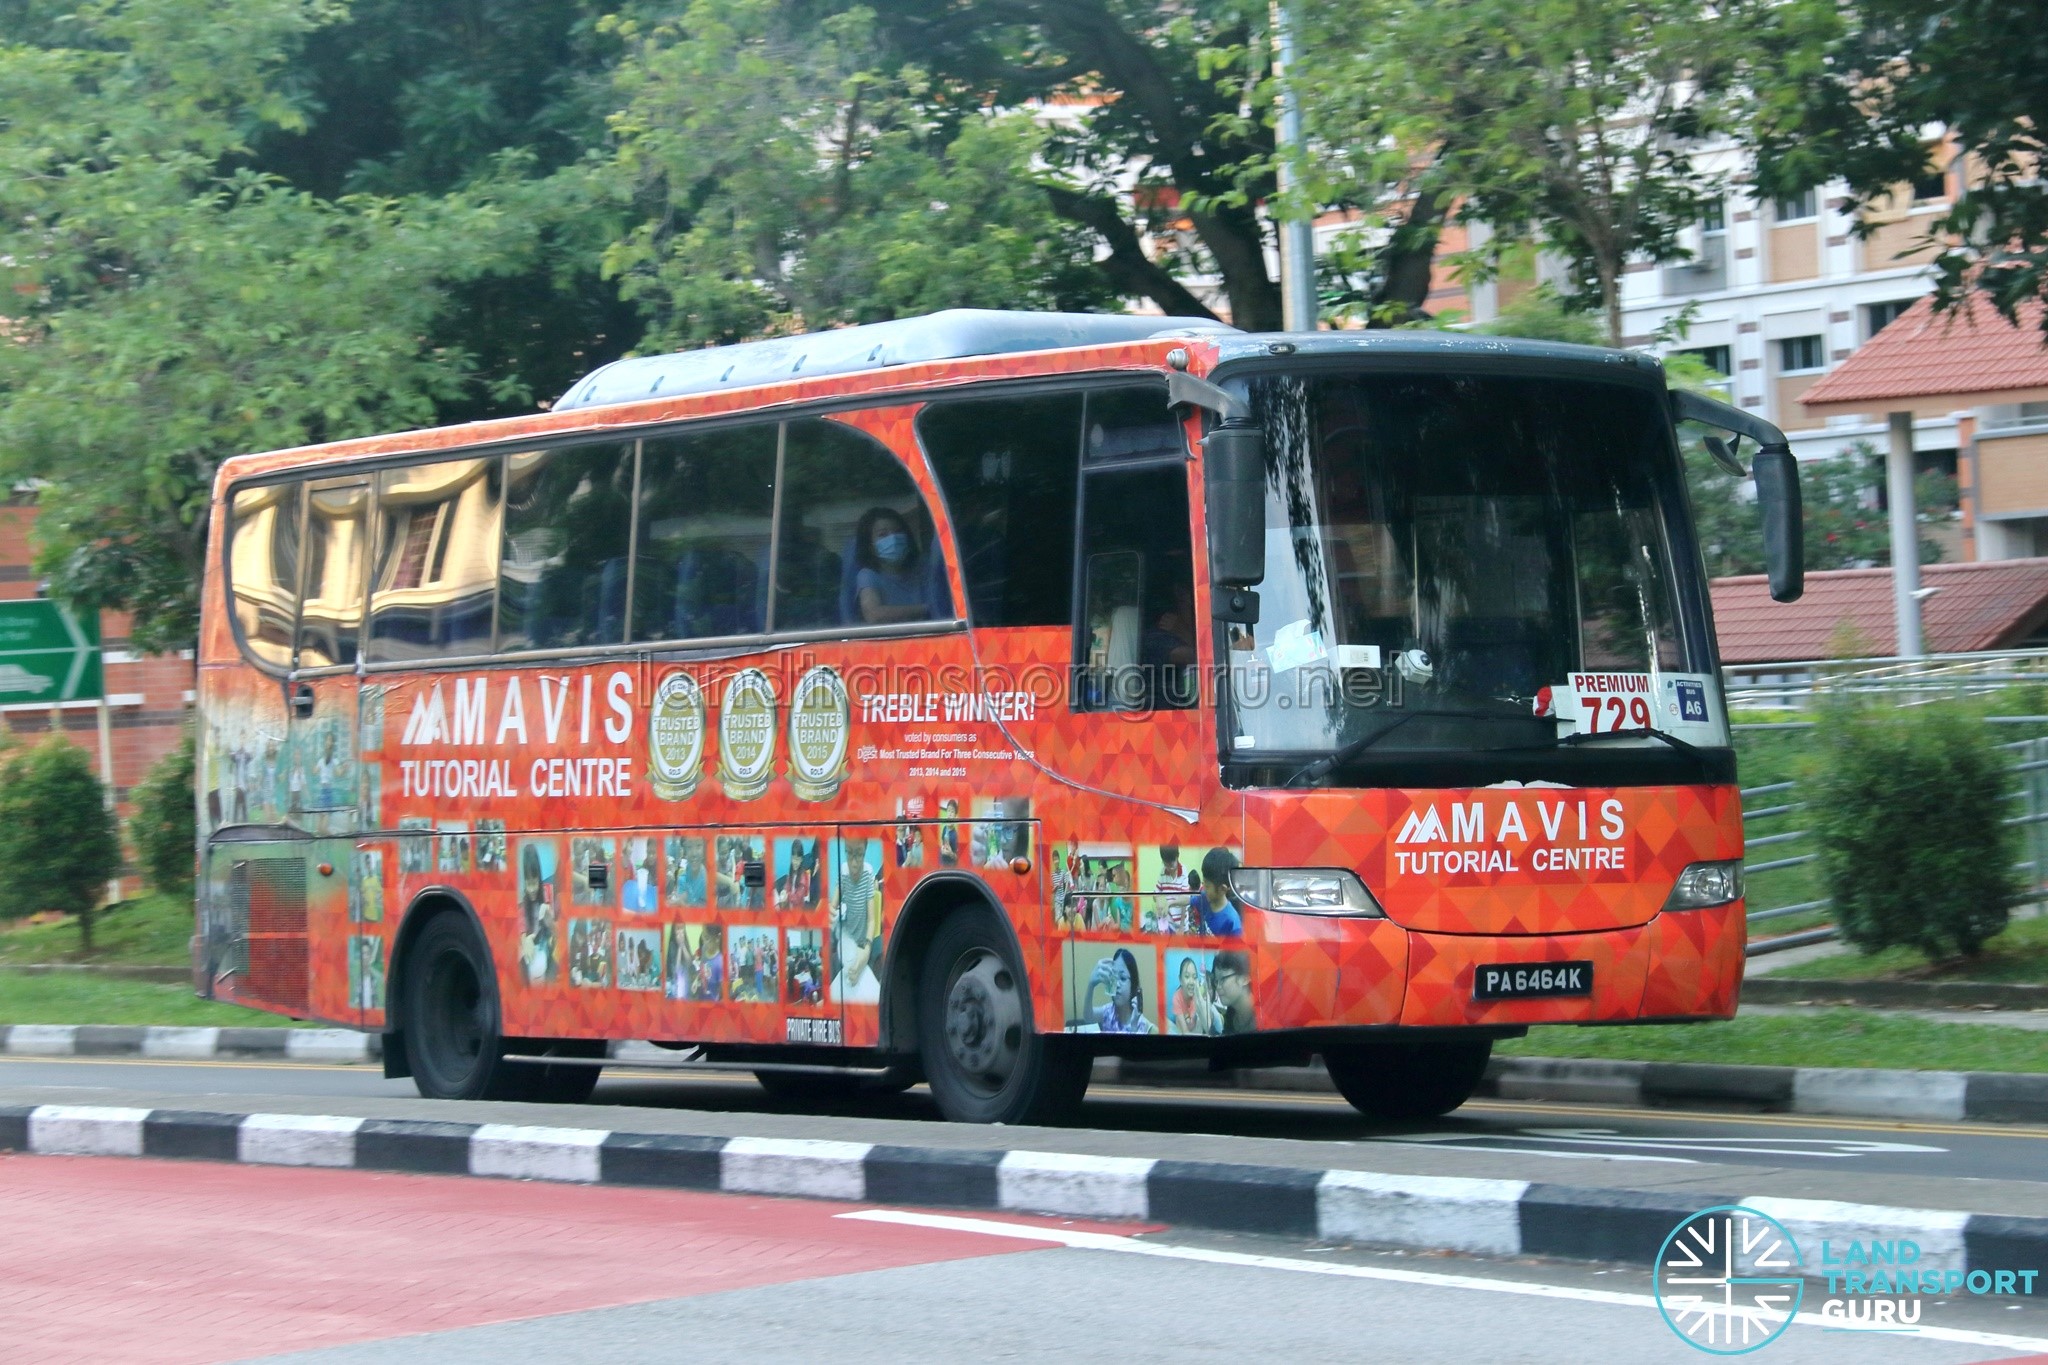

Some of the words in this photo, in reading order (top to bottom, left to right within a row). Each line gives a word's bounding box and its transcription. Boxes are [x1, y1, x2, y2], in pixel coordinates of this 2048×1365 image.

[1574, 674, 1650, 693] PREMIUM
[452, 671, 633, 746] MAVIS
[860, 693, 939, 723] TREBLE
[944, 691, 1036, 723] WINNER!
[1685, 700, 1703, 715] A6
[653, 715, 700, 731] TRUSTED
[724, 713, 772, 730] TRUSTED
[794, 712, 844, 730] TRUSTED
[1581, 696, 1651, 735] 729
[659, 731, 696, 746] BRAND
[729, 730, 767, 745] BRAND
[800, 729, 838, 744] BRAND
[904, 732, 922, 743] voted
[923, 732, 931, 745] by
[932, 733, 967, 743] consumers
[968, 733, 977, 743] as
[665, 747, 686, 761] 2013
[735, 746, 757, 760] 2014
[806, 746, 828, 760] 2015
[879, 749, 895, 759] Most
[896, 748, 920, 759] Trusted
[920, 748, 940, 759] Brand
[941, 749, 952, 759] For
[953, 748, 972, 759] Three
[972, 748, 1013, 760] Consecutive
[399, 758, 518, 798] TUTORIAL
[530, 756, 632, 798] CENTRE
[739, 767, 752, 776] GOLD
[810, 767, 823, 776] GOLD
[925, 767, 939, 777] 2014
[940, 767, 951, 777] and
[952, 767, 966, 777] 2015
[1451, 798, 1625, 843] MAVIS
[1394, 850, 1519, 874] TUTORIAL
[1532, 847, 1625, 871] CENTRE
[1486, 968, 1582, 992] PA6464K
[786, 1017, 812, 1042] PRIVATE
[812, 1018, 828, 1042] HIRE
[828, 1019, 841, 1043] BUS
